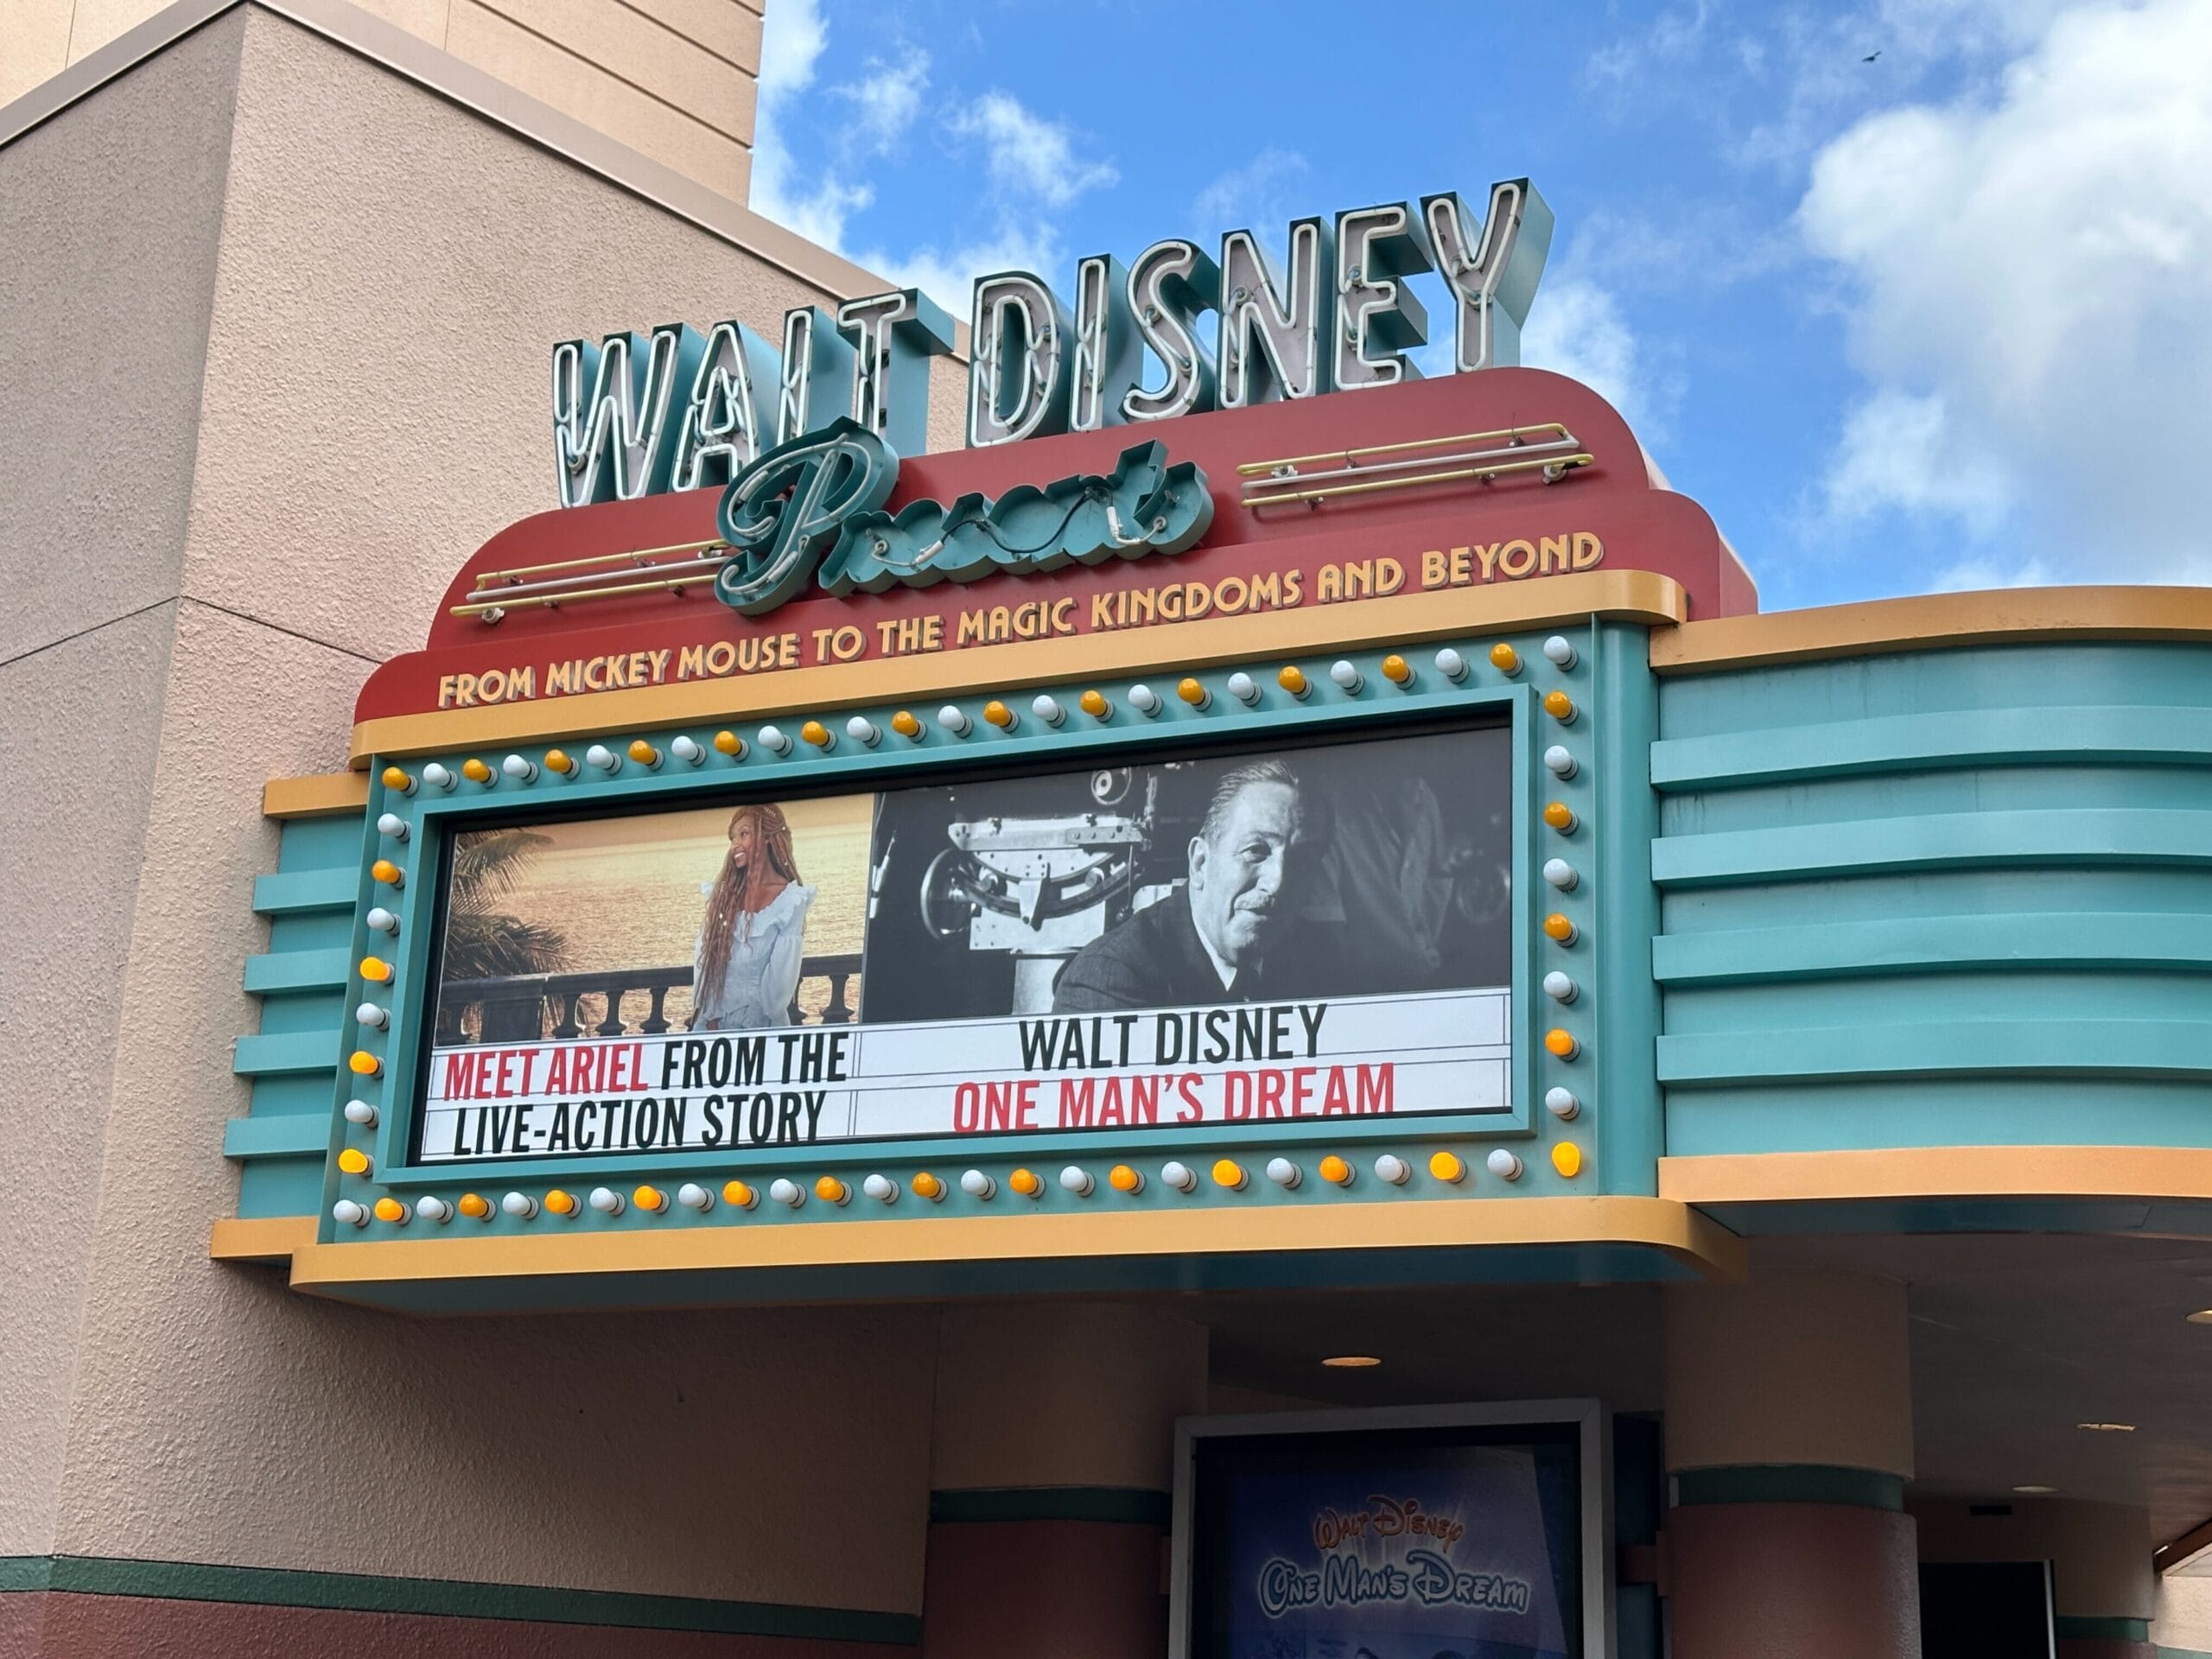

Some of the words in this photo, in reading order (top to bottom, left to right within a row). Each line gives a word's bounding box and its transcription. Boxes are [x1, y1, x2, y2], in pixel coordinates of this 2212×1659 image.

[967, 177, 1534, 448] DISNEY
[438, 666, 535, 709] FROM
[545, 650, 671, 695] MICKEY
[677, 633, 799, 680] MOUSE
[812, 625, 865, 662] TO
[877, 615, 944, 655] THE
[957, 597, 1076, 645] MAGIC
[1091, 568, 1304, 630] KINGDOMS
[1318, 557, 1405, 601] AND
[1421, 531, 1604, 587] BEYOND
[443, 1047, 540, 1101] MEET
[545, 1043, 648, 1096] ARIEL
[661, 1036, 766, 1090] FROM
[779, 1032, 849, 1084] THE
[1019, 1014, 1138, 1071] WALT
[1155, 1003, 1328, 1065] DISNEY
[454, 1096, 689, 1155] LIVE-ACTION
[702, 1090, 827, 1146] STORY
[954, 1080, 1039, 1134] ONE
[1058, 1072, 1204, 1128] MAN'S
[1224, 1062, 1395, 1121] DREAM
